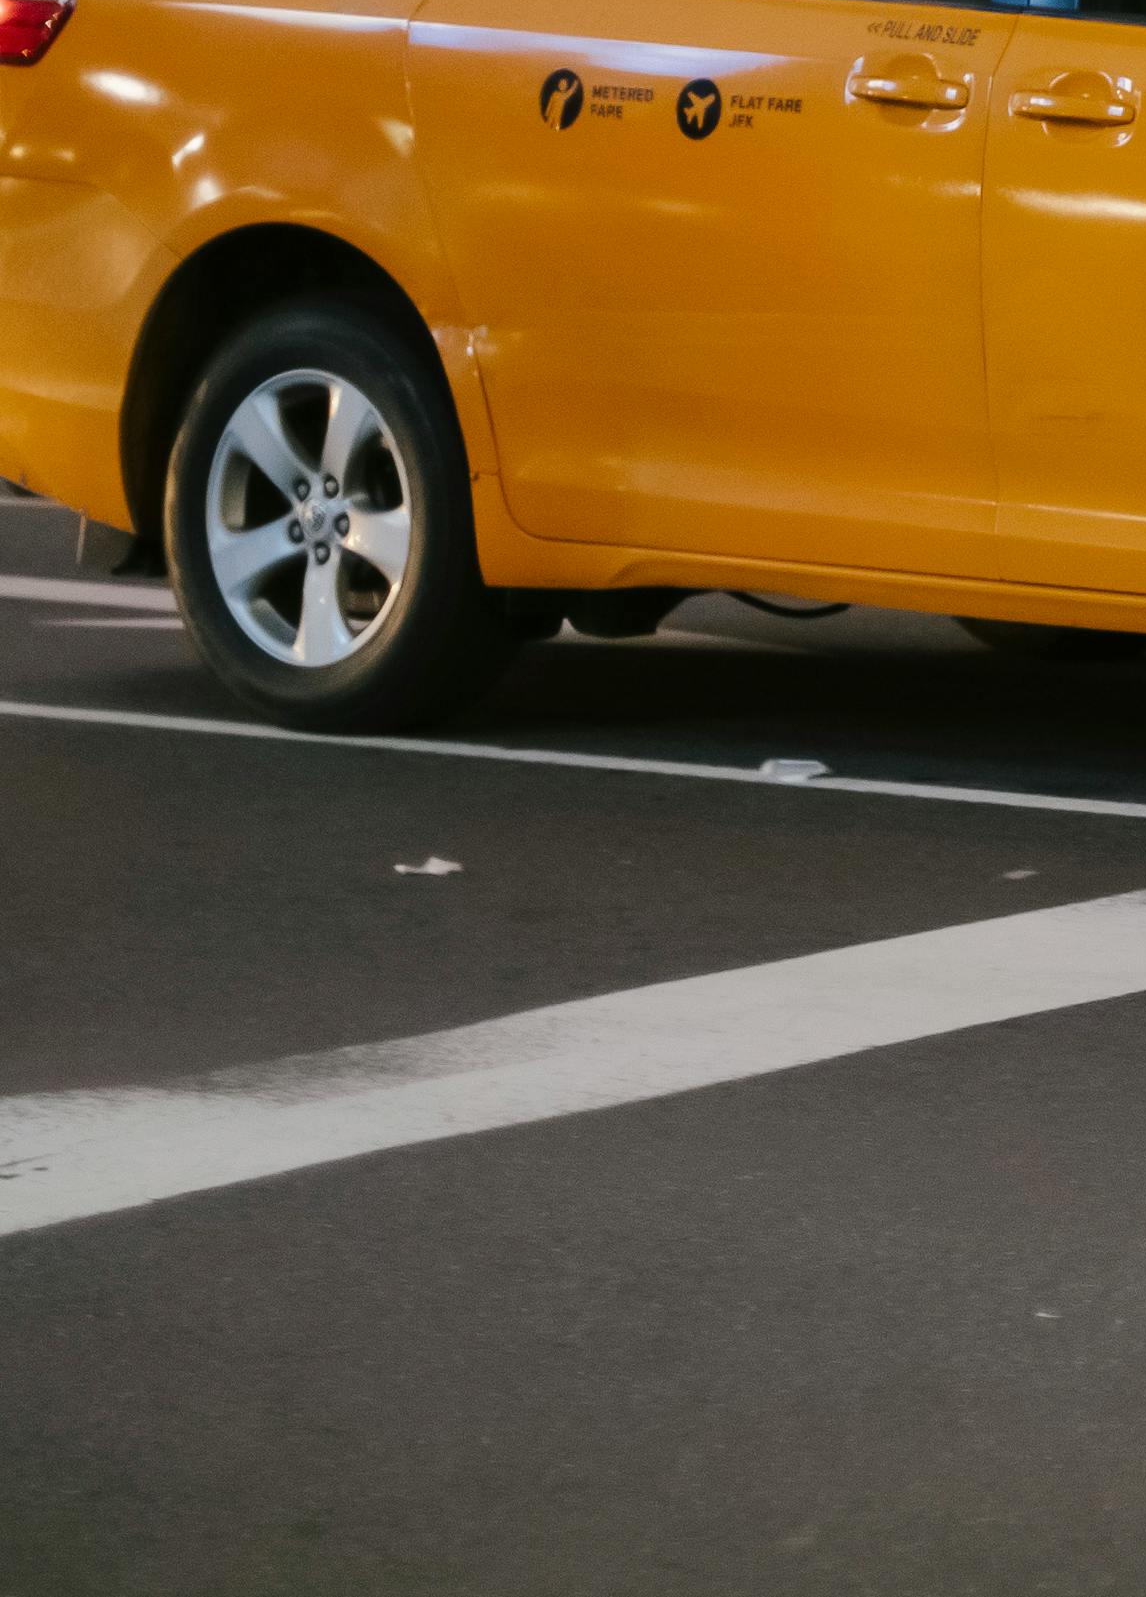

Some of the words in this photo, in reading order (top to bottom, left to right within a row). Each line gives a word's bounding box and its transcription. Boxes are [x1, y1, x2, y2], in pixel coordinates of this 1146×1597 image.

[883, 20, 912, 39] PULL
[914, 24, 943, 42] AND
[943, 26, 981, 46] SLIDE
[592, 85, 654, 102] METERED
[590, 103, 623, 119] FARE
[730, 95, 763, 110] FLAT
[767, 97, 803, 114] FARE
[729, 113, 753, 129] JFK
